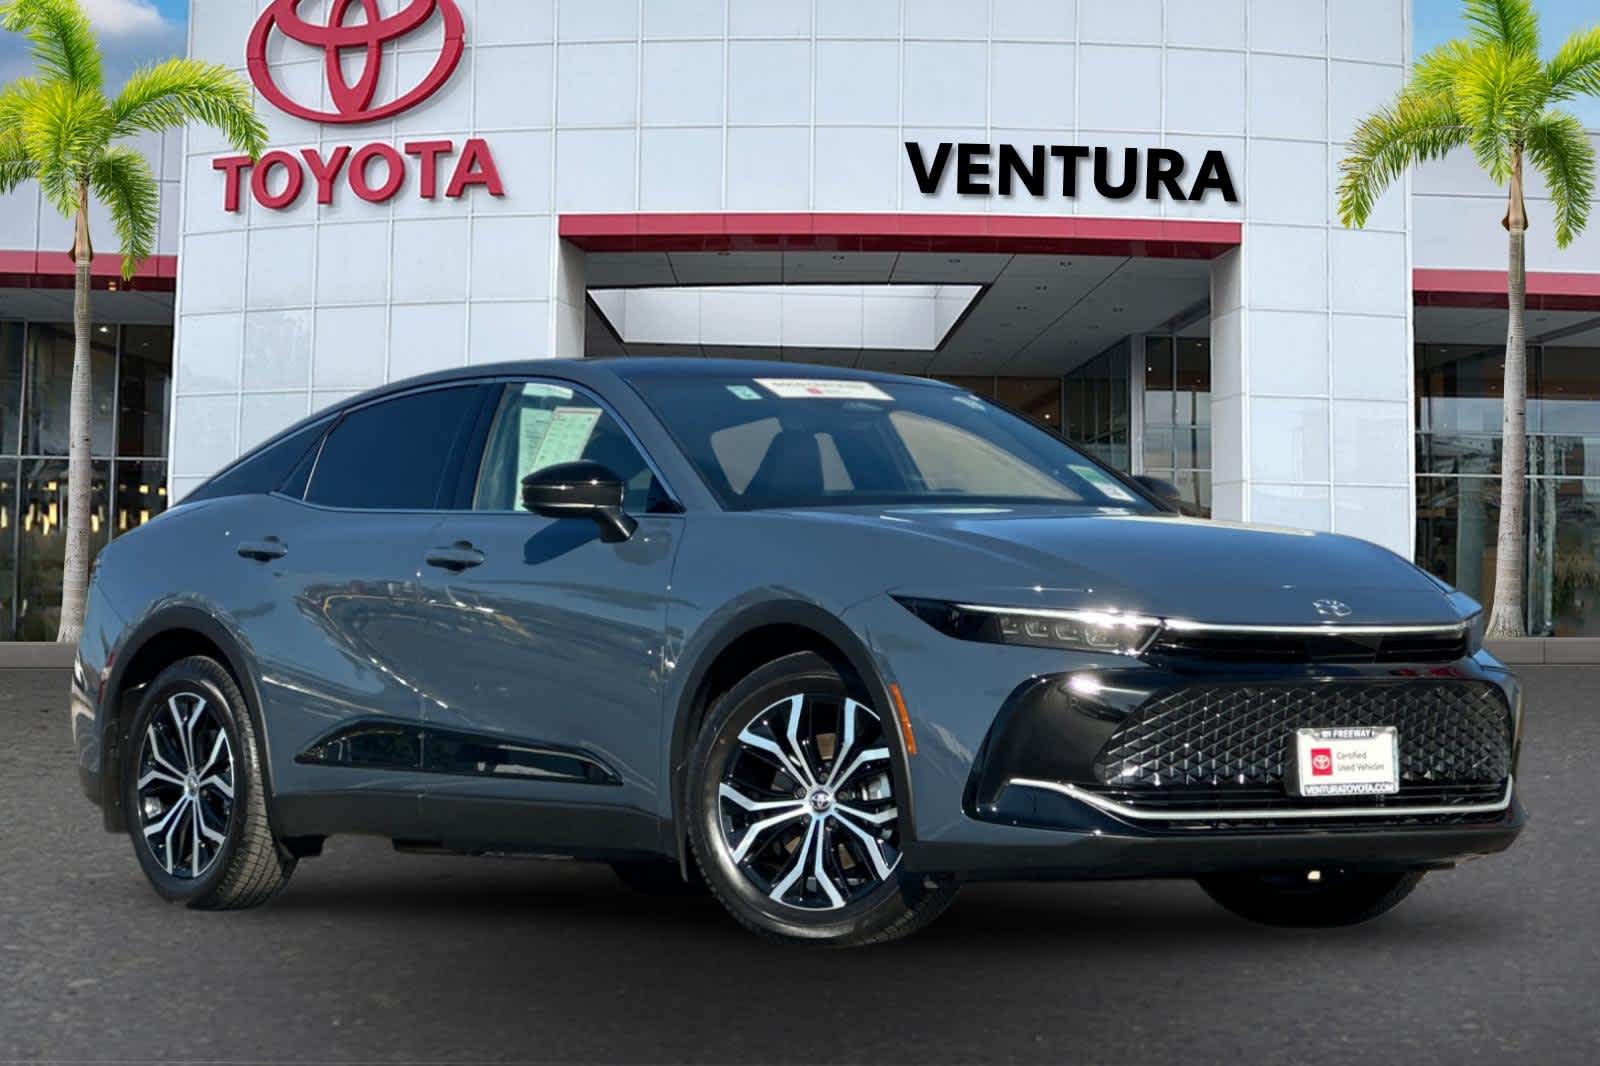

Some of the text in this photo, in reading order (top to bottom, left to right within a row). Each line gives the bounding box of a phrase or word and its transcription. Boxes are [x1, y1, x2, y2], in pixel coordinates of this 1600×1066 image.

[213, 138, 505, 212] TOYOTA
[905, 142, 1237, 202] VENTURA
[1333, 729, 1370, 738] FREEWAY
[1336, 751, 1367, 760] Certified
[1337, 762, 1385, 772] Used Vehicles
